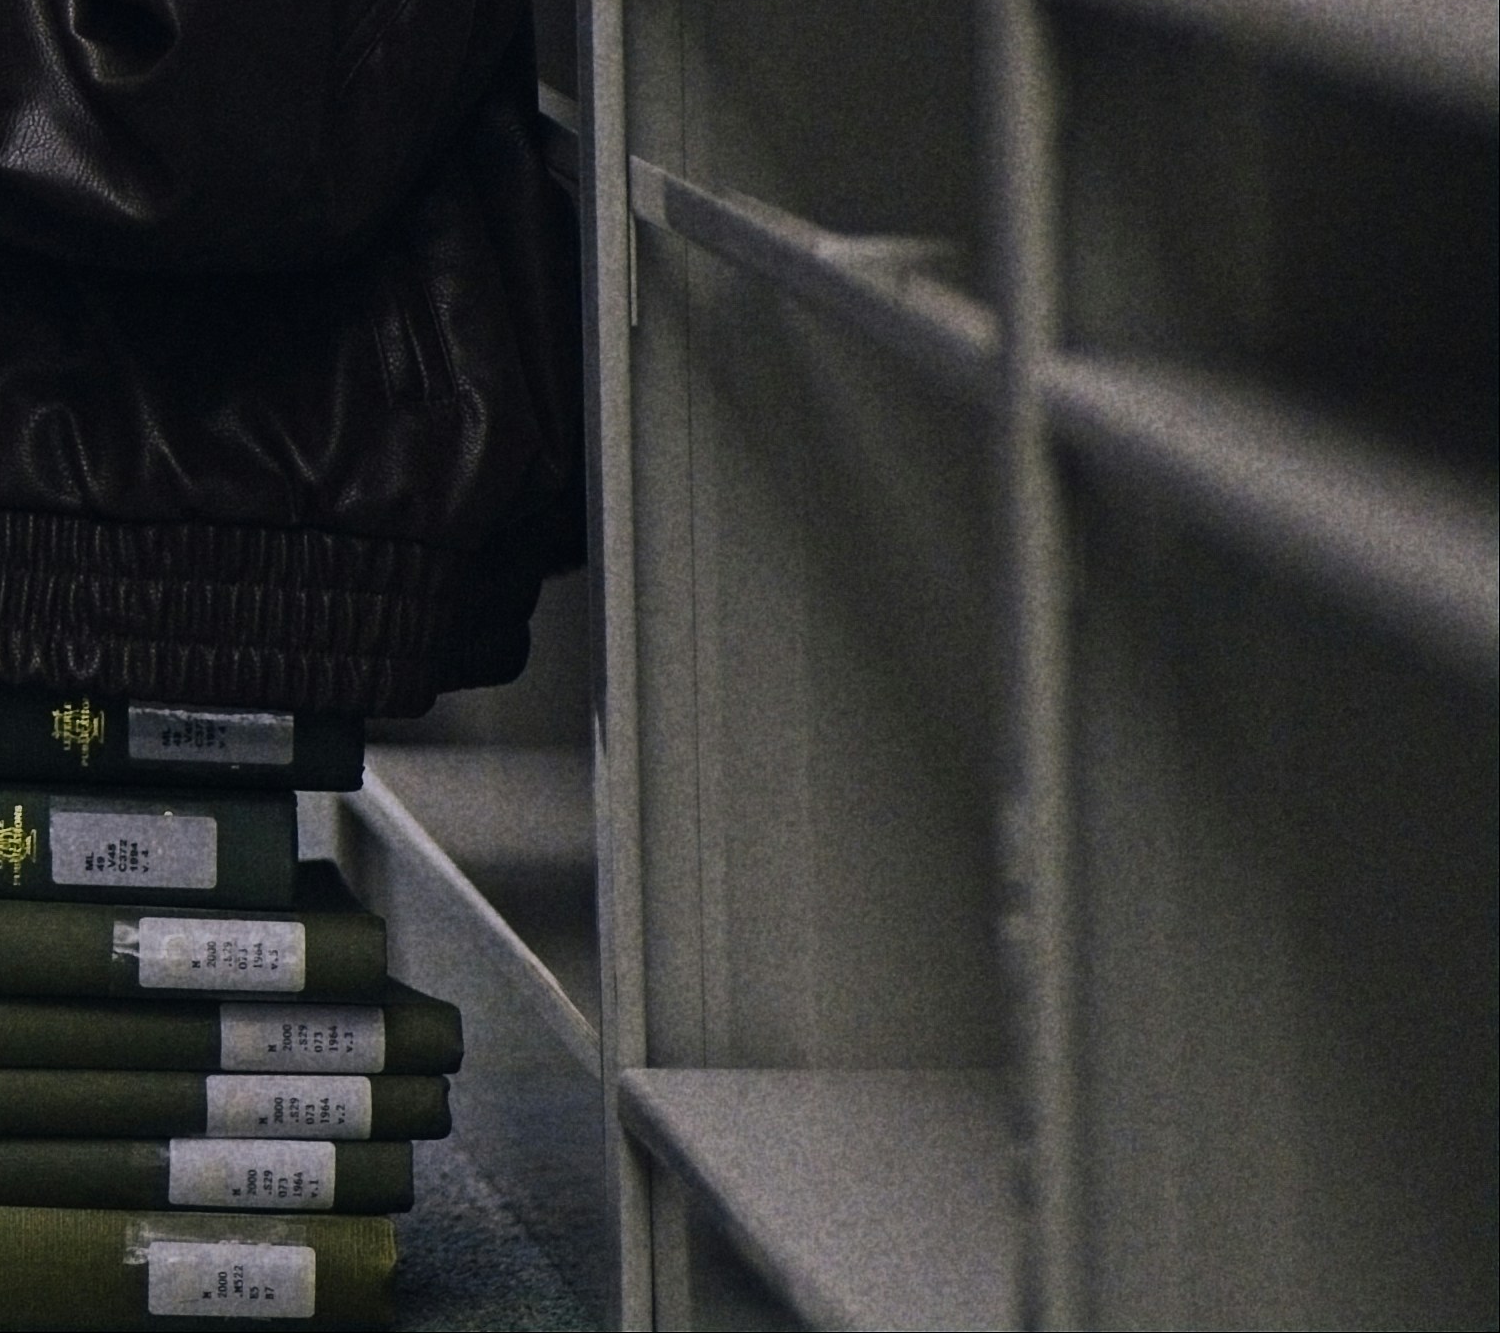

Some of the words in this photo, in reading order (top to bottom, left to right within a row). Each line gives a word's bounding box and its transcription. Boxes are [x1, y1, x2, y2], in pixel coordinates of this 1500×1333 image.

[85, 851, 94, 871] ML
[97, 856, 105, 872] 49
[107, 843, 116, 872] .V45
[118, 839, 128, 872] C372
[130, 842, 139, 872] 1994
[192, 960, 201, 969] M
[206, 940, 217, 968] 2000
[252, 942, 263, 969] 1964
[268, 1044, 277, 1053] M
[282, 1024, 292, 1052] 2000
[299, 1024, 308, 1052] .S29
[328, 1024, 338, 1052] 1964
[344, 1032, 353, 1053] v.3
[258, 1116, 268, 1125] M
[274, 1096, 283, 1124] 2000
[289, 1097, 299, 1123] .S29
[320, 1097, 330, 1124] 1964
[336, 1104, 346, 1125] v.2
[232, 1188, 241, 1196] M
[247, 1169, 257, 1195] 2000
[263, 1170, 273, 1195] .S29
[293, 1172, 303, 1197] 1964
[309, 1180, 319, 1198] v.1
[217, 1271, 227, 1298] 2000
[233, 1265, 243, 1298] .M522
[264, 1286, 274, 1300] B7
[202, 1291, 212, 1300] M
